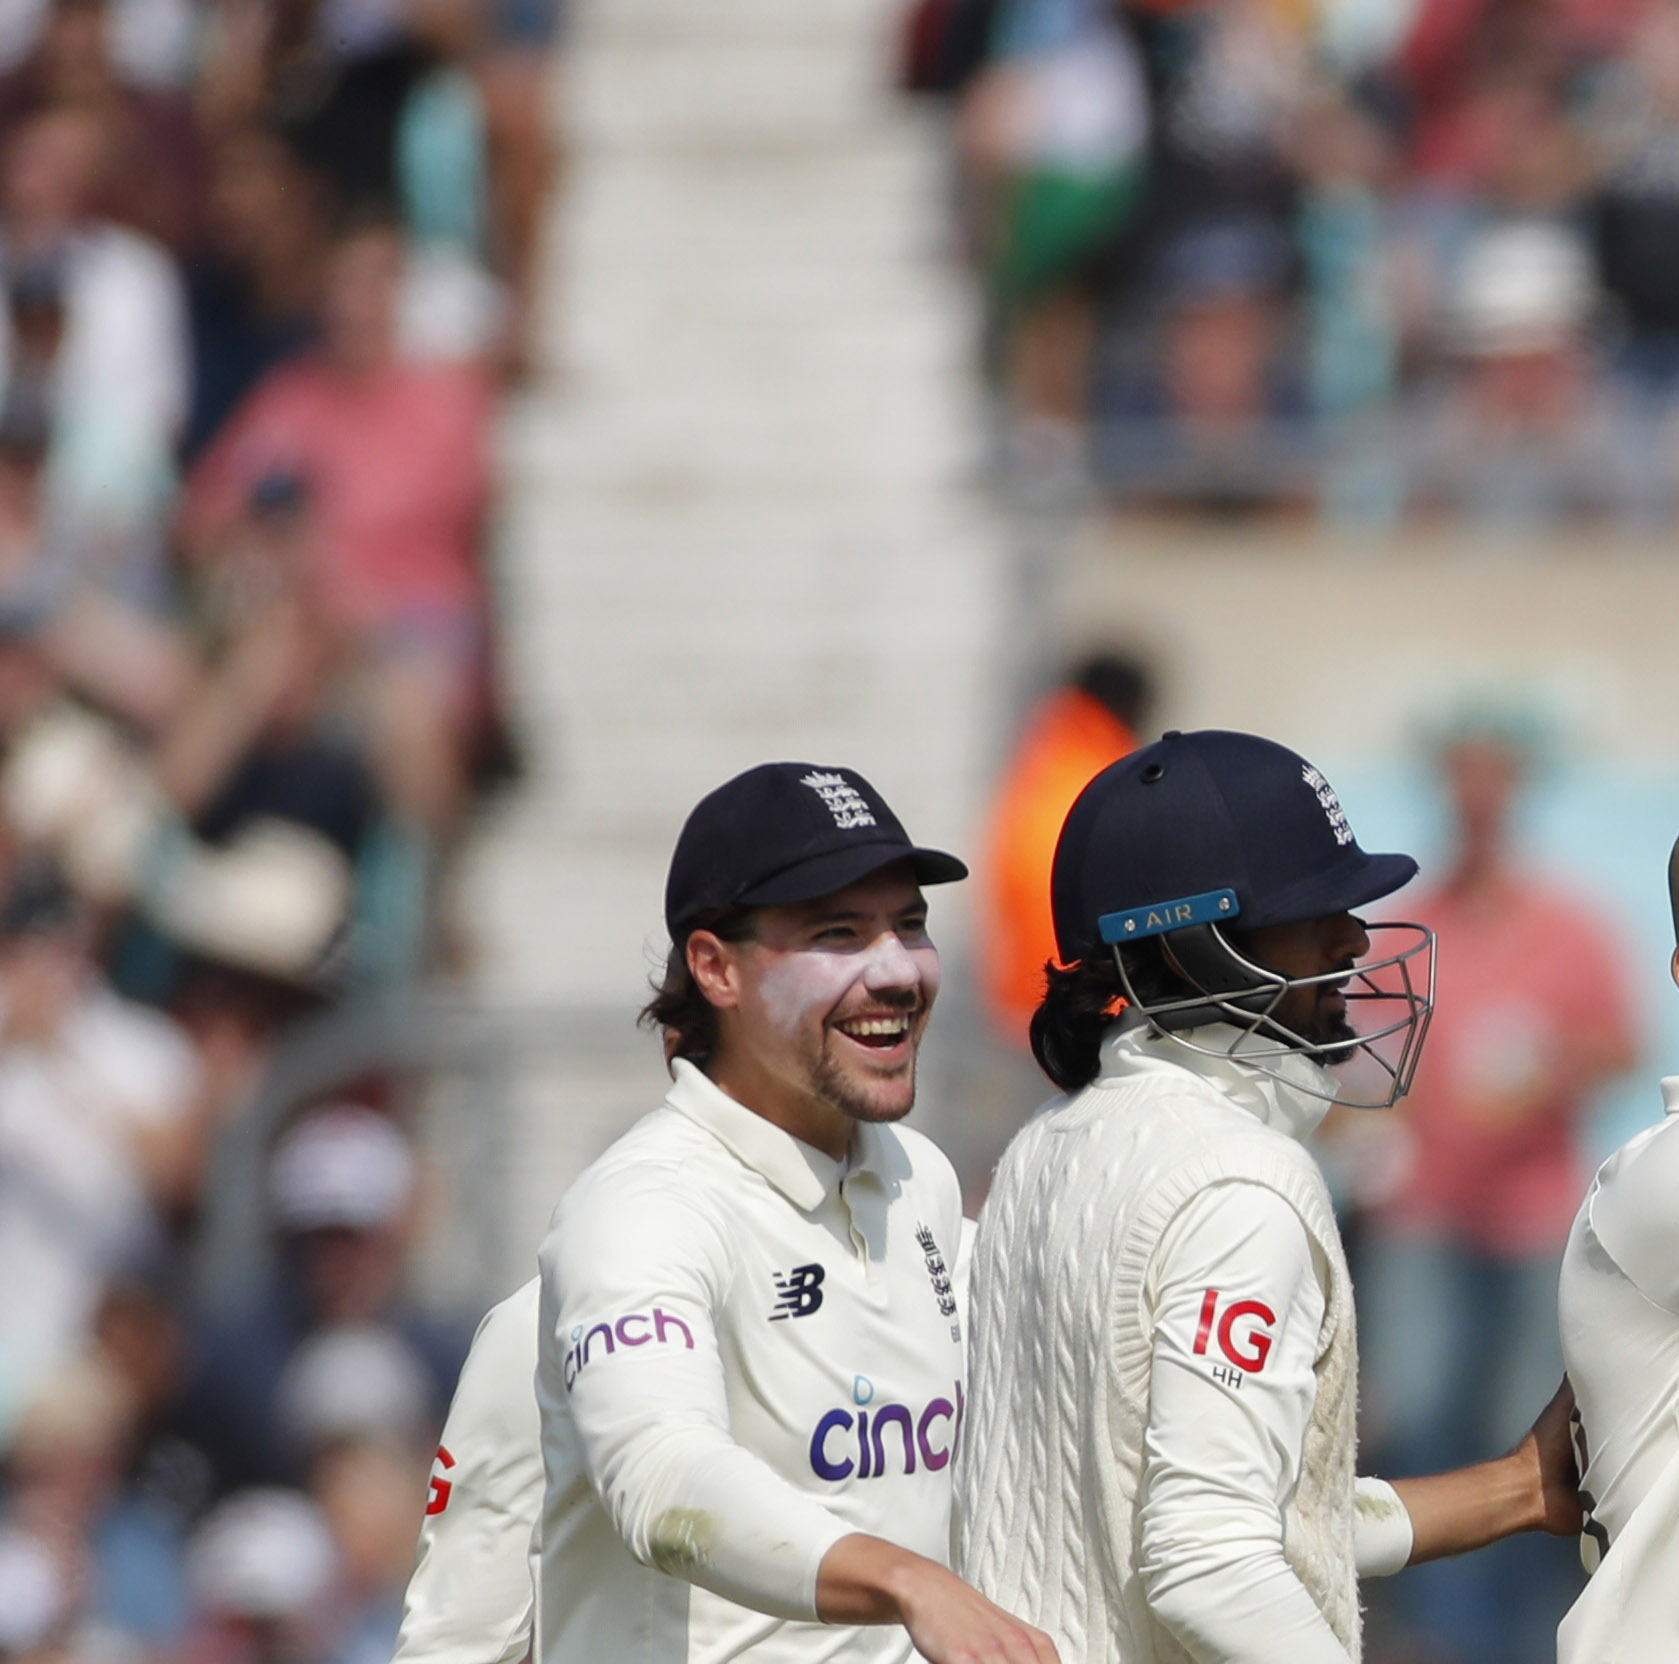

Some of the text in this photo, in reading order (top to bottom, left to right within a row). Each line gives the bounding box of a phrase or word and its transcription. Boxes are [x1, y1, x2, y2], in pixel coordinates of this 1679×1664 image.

[1146, 903, 1193, 930] AIR
[563, 1308, 696, 1393] cinch
[1192, 1287, 1277, 1374] IG
